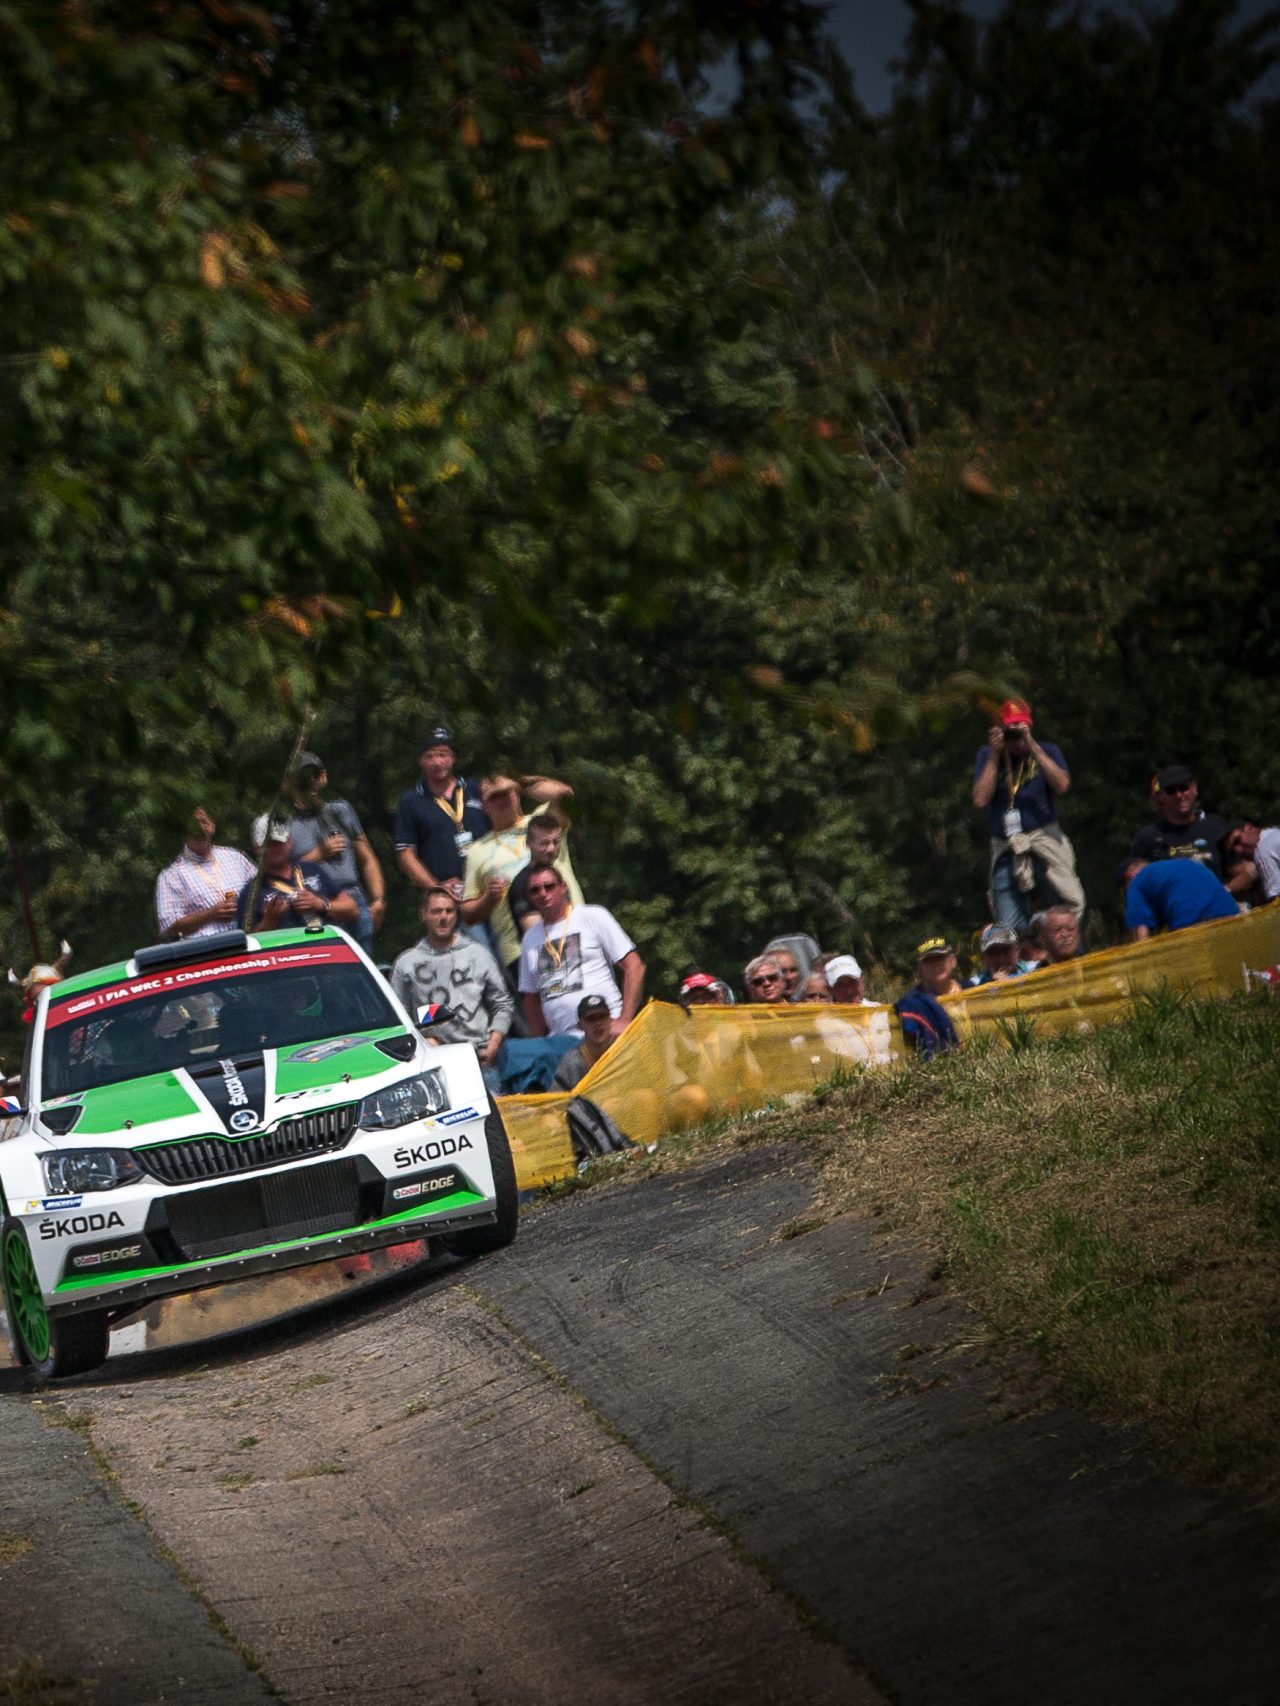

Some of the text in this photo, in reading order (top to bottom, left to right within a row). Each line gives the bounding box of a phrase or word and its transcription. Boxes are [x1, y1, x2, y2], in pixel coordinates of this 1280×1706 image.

[105, 958, 270, 1002] FIA WRC 2 Championship
[224, 1073, 249, 1107] ŠKODA
[393, 1133, 474, 1169] ŠKODA
[421, 1174, 455, 1193] EDGE
[38, 1211, 125, 1241] ŠKODA
[101, 1244, 142, 1263] EDGE
